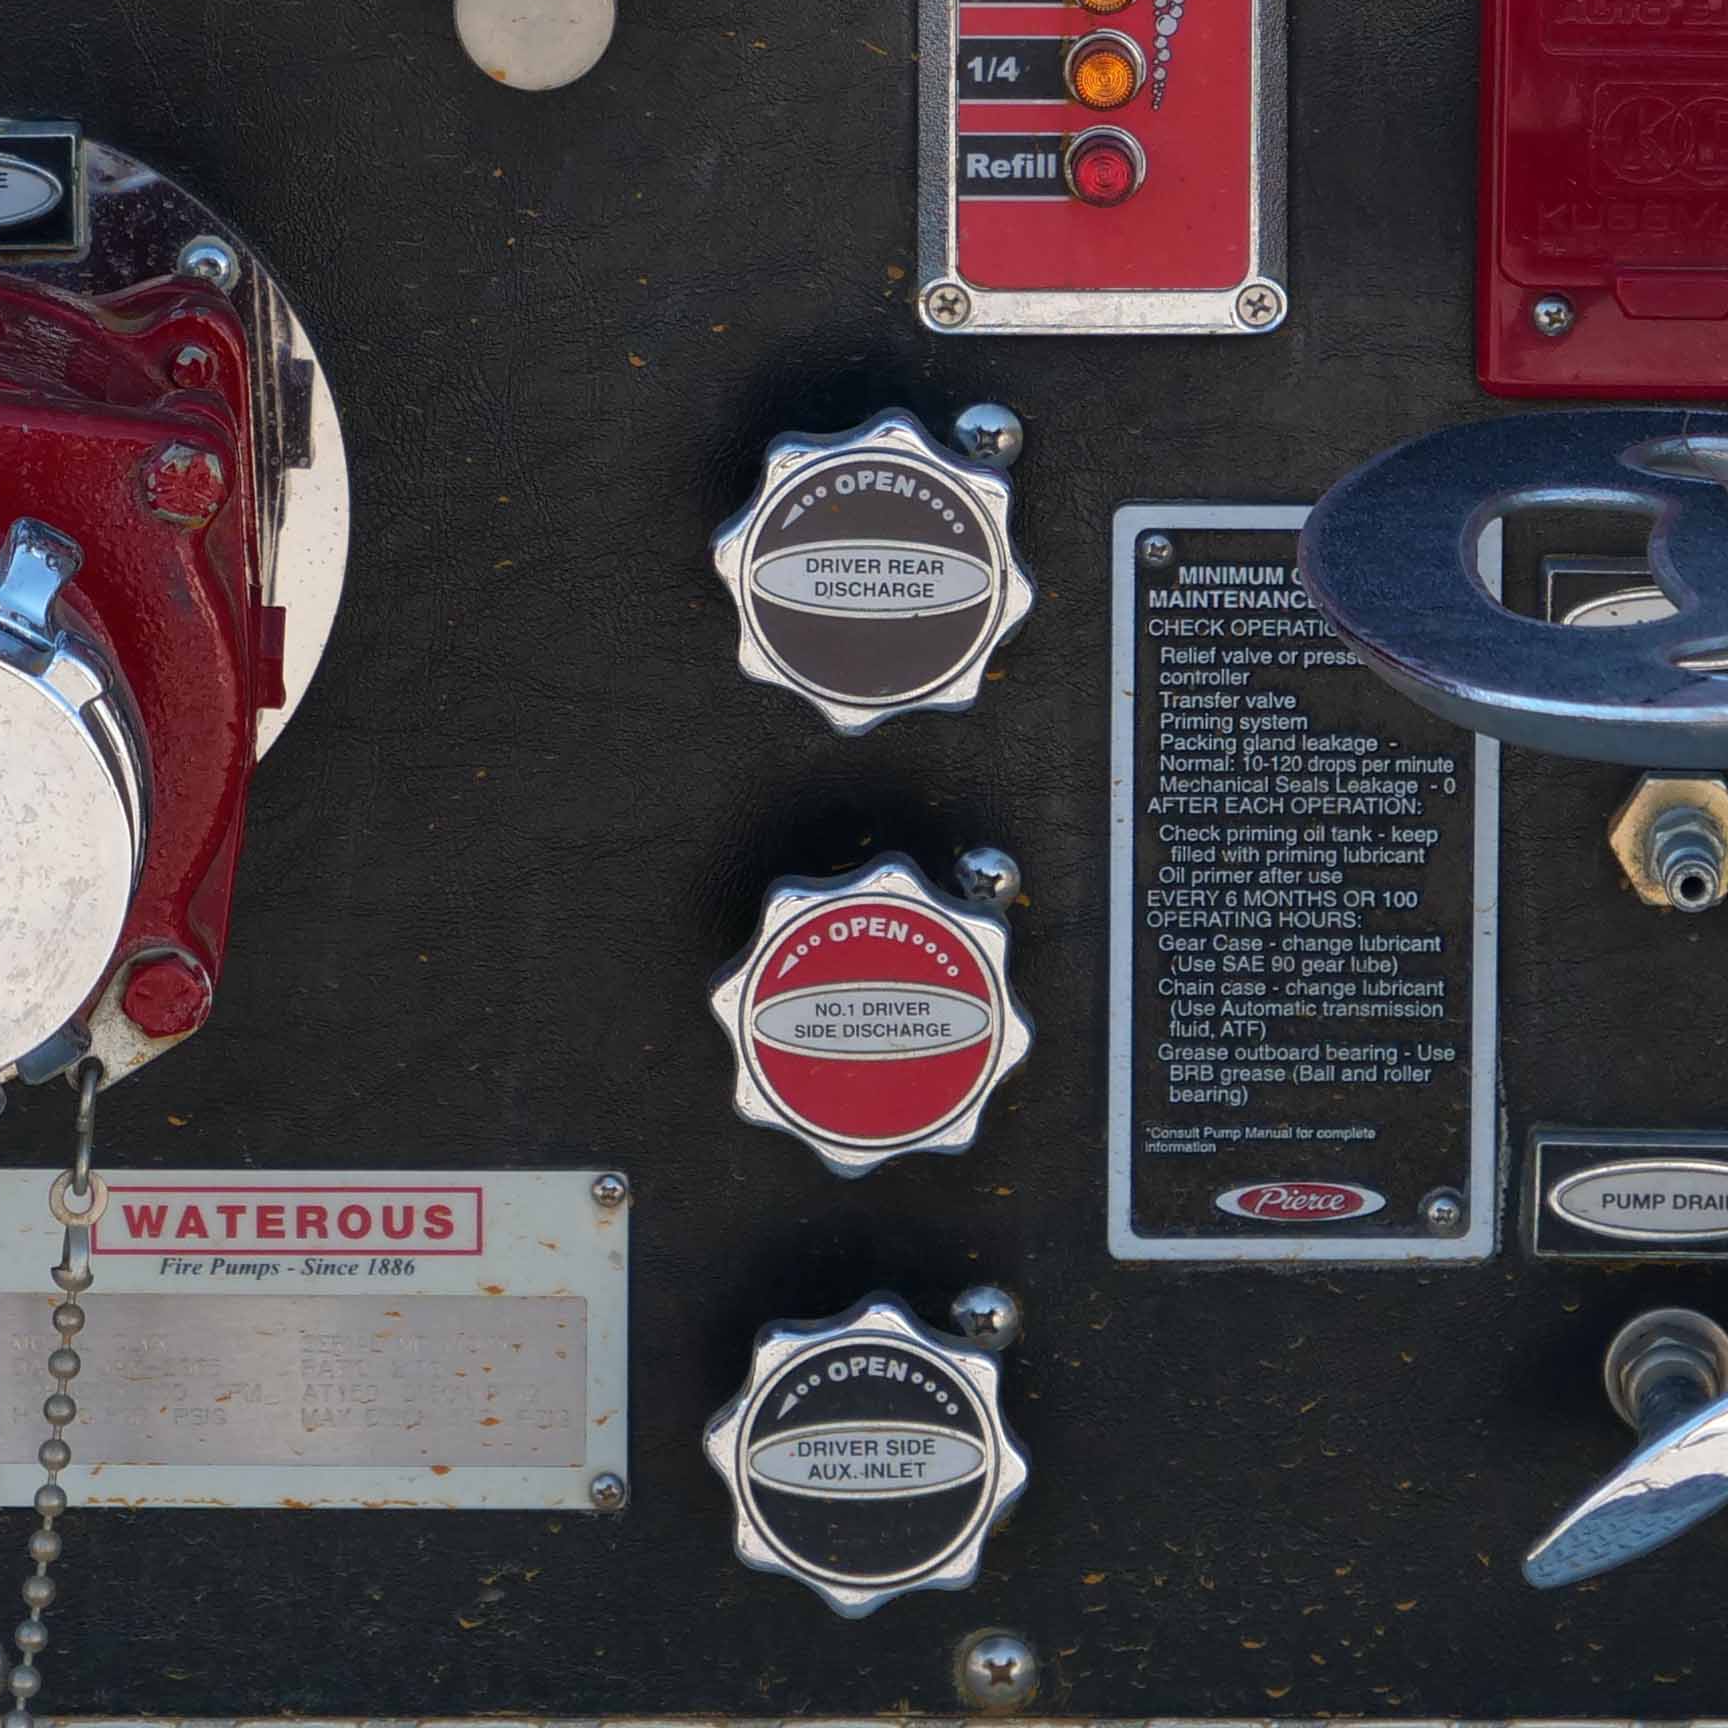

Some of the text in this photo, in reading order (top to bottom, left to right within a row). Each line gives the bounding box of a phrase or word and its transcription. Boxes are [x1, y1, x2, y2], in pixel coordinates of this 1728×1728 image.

[967, 56, 1021, 84] 1/4
[966, 153, 1057, 179] Refill
[835, 470, 916, 497] OPEN
[805, 558, 944, 575] DRIVER REAR
[1178, 567, 1284, 585] MINIMUM
[814, 582, 934, 599] DISCHARGE
[1148, 619, 1225, 637] CHECK
[1160, 647, 1299, 665] Relief valve or
[1159, 670, 1250, 686] controller
[1159, 692, 1297, 709] Transfer valve
[1160, 713, 1309, 733] Priming system
[1160, 757, 1455, 777] Normal: 10-120 drops per minute
[1146, 797, 1423, 815] AFTER EACH OPERATION:
[1170, 846, 1426, 867] filled with priming lubricant
[1147, 890, 1418, 908] EVERY 6 MONTHS OR 100
[1146, 911, 1362, 929] OPERATING HOURS:
[828, 917, 909, 944] OPEN
[1170, 955, 1398, 977] (Use SAE 90 gear lube)
[815, 1002, 931, 1017] NO.1 DRIVER
[794, 1023, 952, 1039] SIDE DISCHARGE
[1168, 1020, 1267, 1040] fluid, ATF)
[1168, 1086, 1248, 1107] bearing)
[1254, 1187, 1346, 1214] Pierce
[1601, 1193, 1665, 1209] PUMP
[122, 1204, 455, 1240] WATEROUS
[159, 1257, 202, 1276] Fire
[207, 1258, 281, 1281] Pumps
[301, 1258, 361, 1277] Since
[367, 1258, 416, 1277] 1886
[827, 1356, 908, 1383] OPEN
[798, 1439, 936, 1457] DRIVER SIDE
[808, 1462, 926, 1481] AUX. INLET
